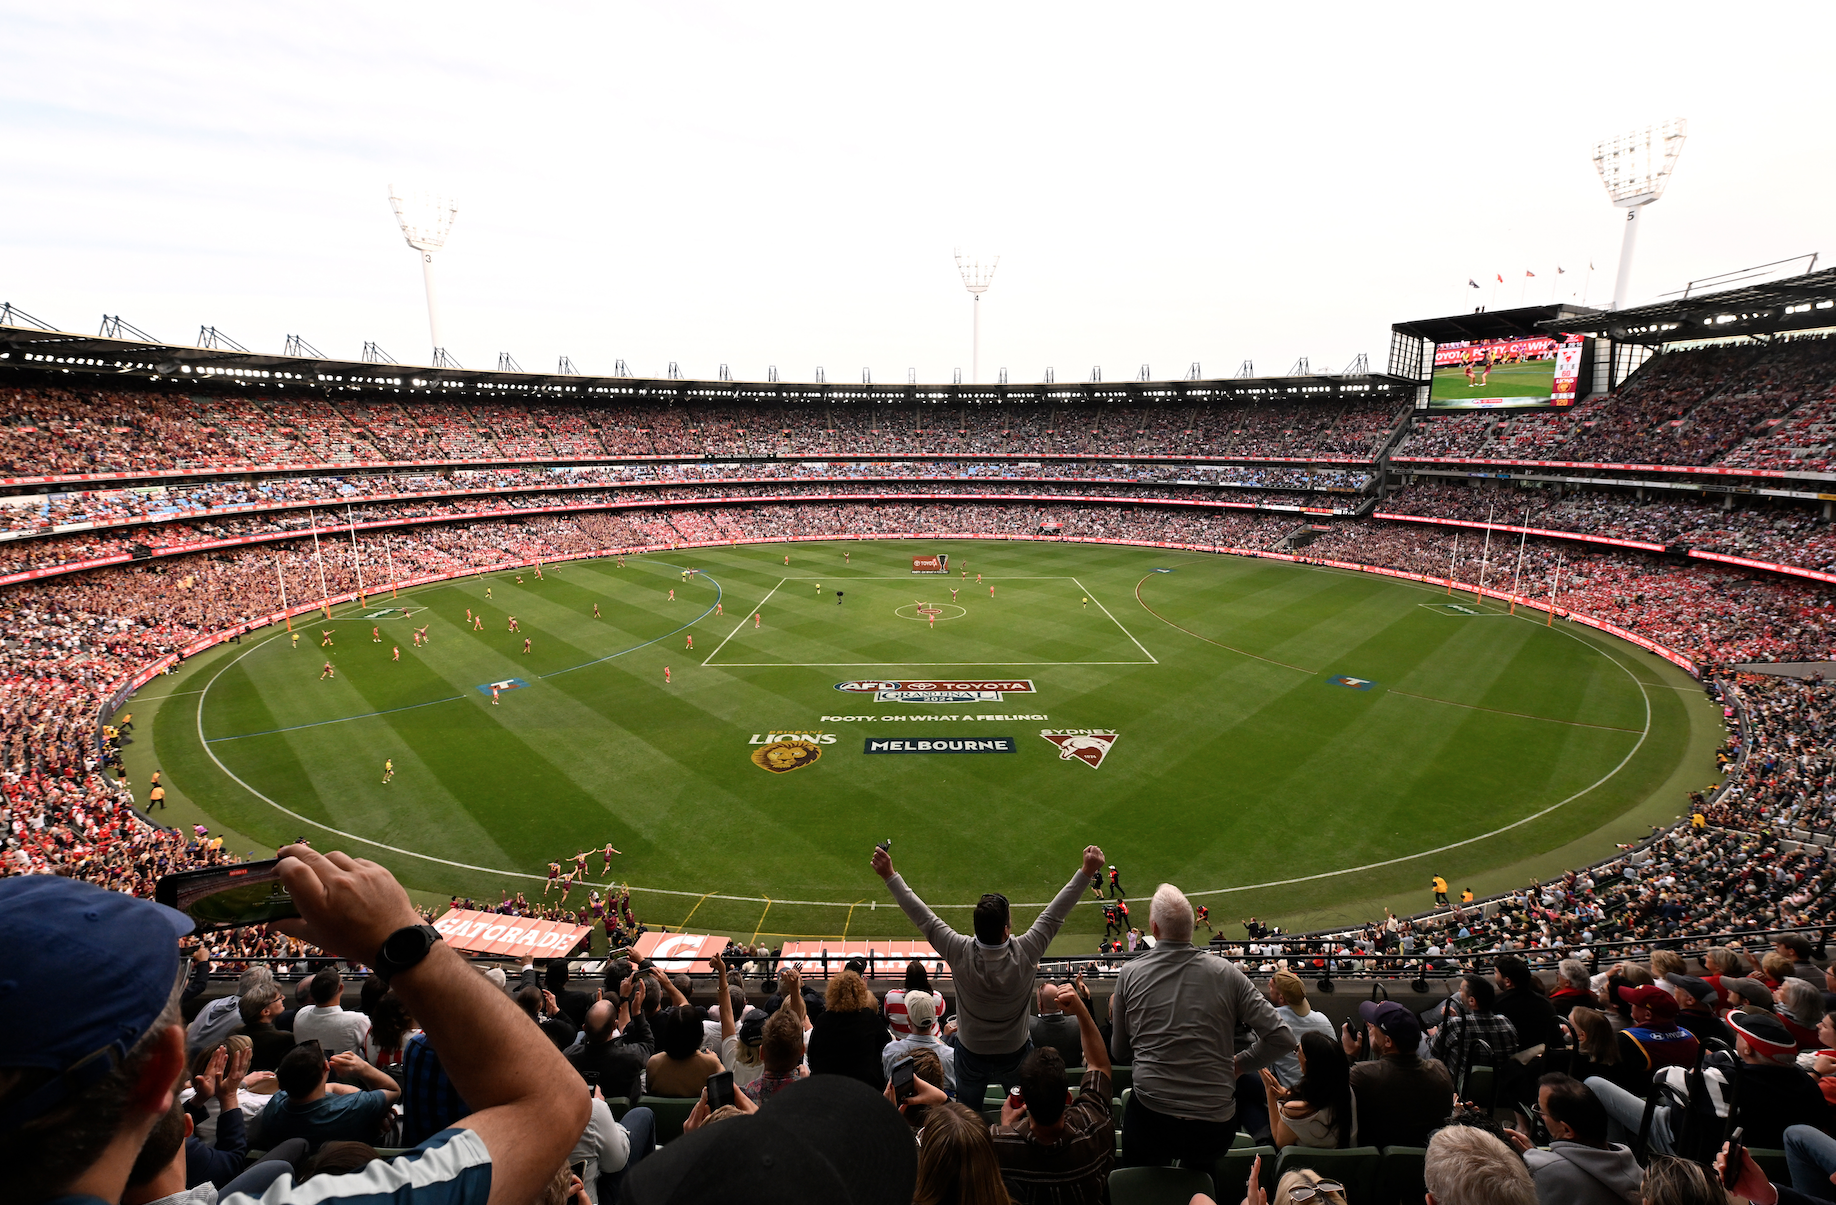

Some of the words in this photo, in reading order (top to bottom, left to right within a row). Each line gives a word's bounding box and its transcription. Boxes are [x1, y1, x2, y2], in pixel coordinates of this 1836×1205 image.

[1627, 210, 1634, 221] 5
[425, 254, 431, 263] 3
[842, 682, 895, 690] AFL
[748, 734, 837, 744] LIONS
[871, 740, 1008, 751] MELBOURNE
[434, 919, 577, 950] GATORADE
[652, 935, 704, 970] G
